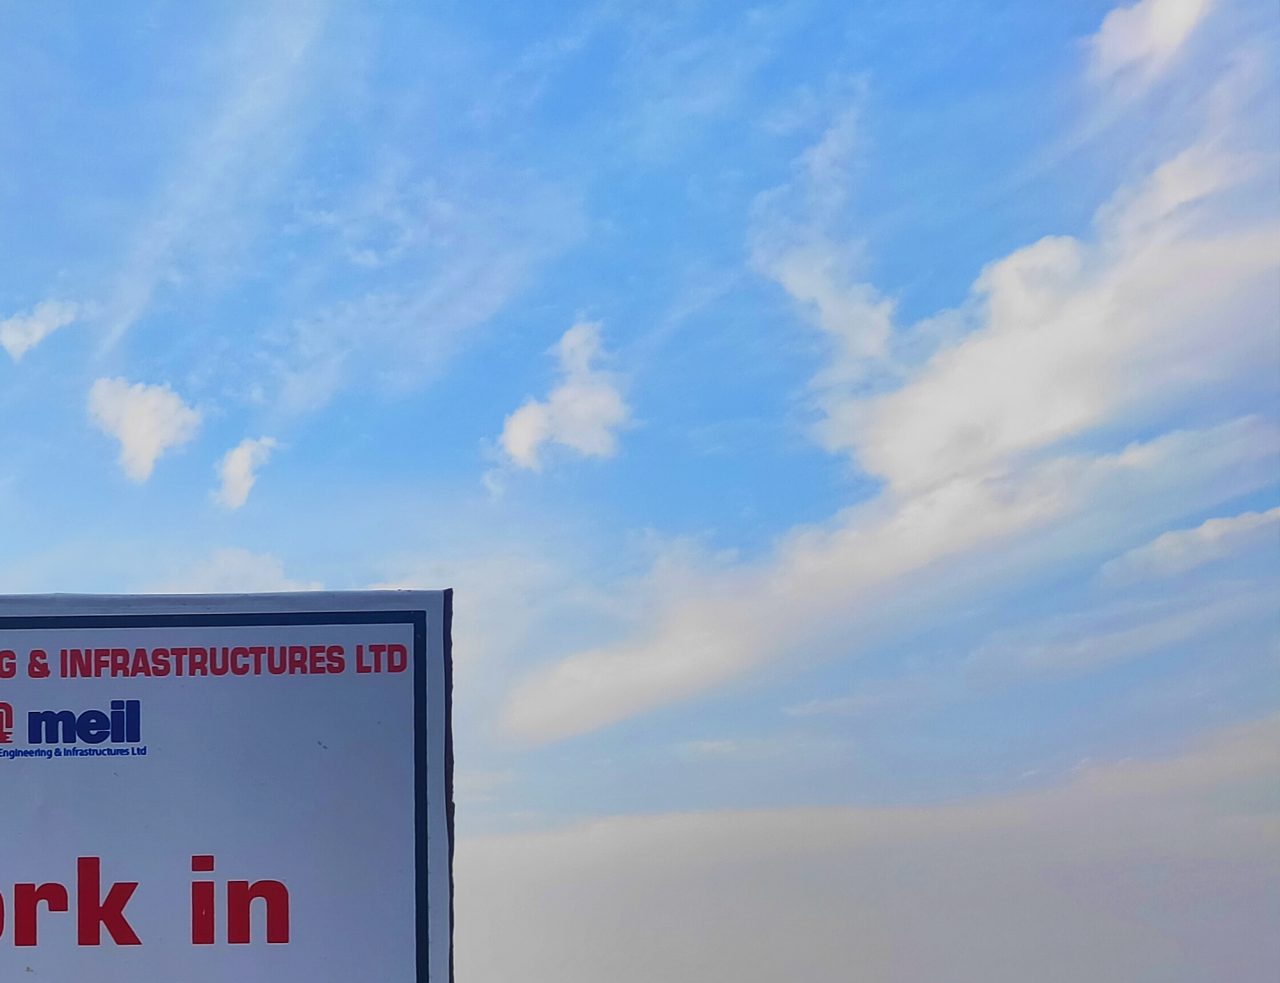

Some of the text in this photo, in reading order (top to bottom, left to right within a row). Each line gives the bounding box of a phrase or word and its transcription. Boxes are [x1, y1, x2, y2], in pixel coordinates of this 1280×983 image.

[28, 650, 50, 679] &
[61, 646, 346, 679] INFRASTRUCTURES
[357, 644, 408, 673] LTD
[27, 699, 141, 744] meil
[54, 747, 62, 757] &
[63, 746, 130, 757] Infrastructures
[131, 746, 147, 756] Ltd
[191, 855, 290, 946] in
